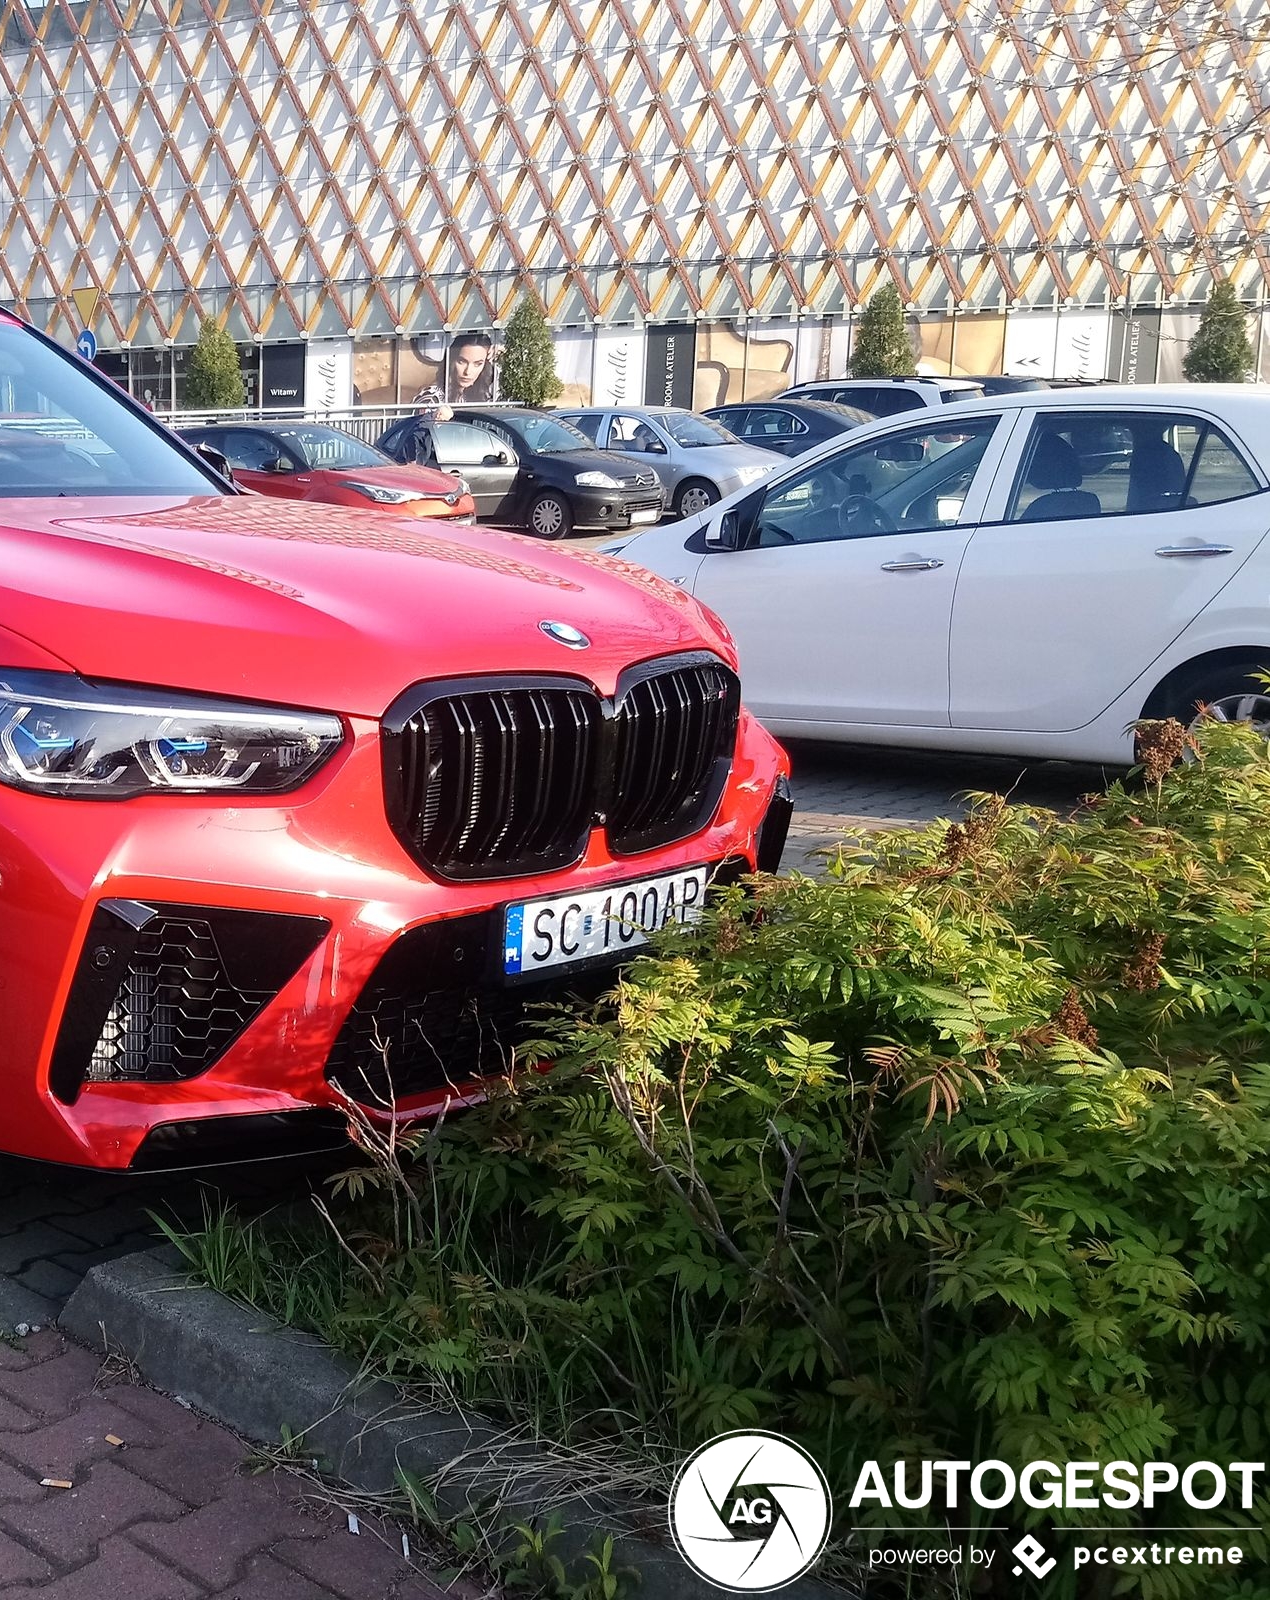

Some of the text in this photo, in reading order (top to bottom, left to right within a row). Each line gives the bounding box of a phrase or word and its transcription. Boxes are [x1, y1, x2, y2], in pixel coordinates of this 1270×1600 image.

[666, 336, 675, 372] ATELIER
[270, 388, 298, 397] Witamy
[531, 902, 581, 962] SC
[505, 946, 520, 963] PL
